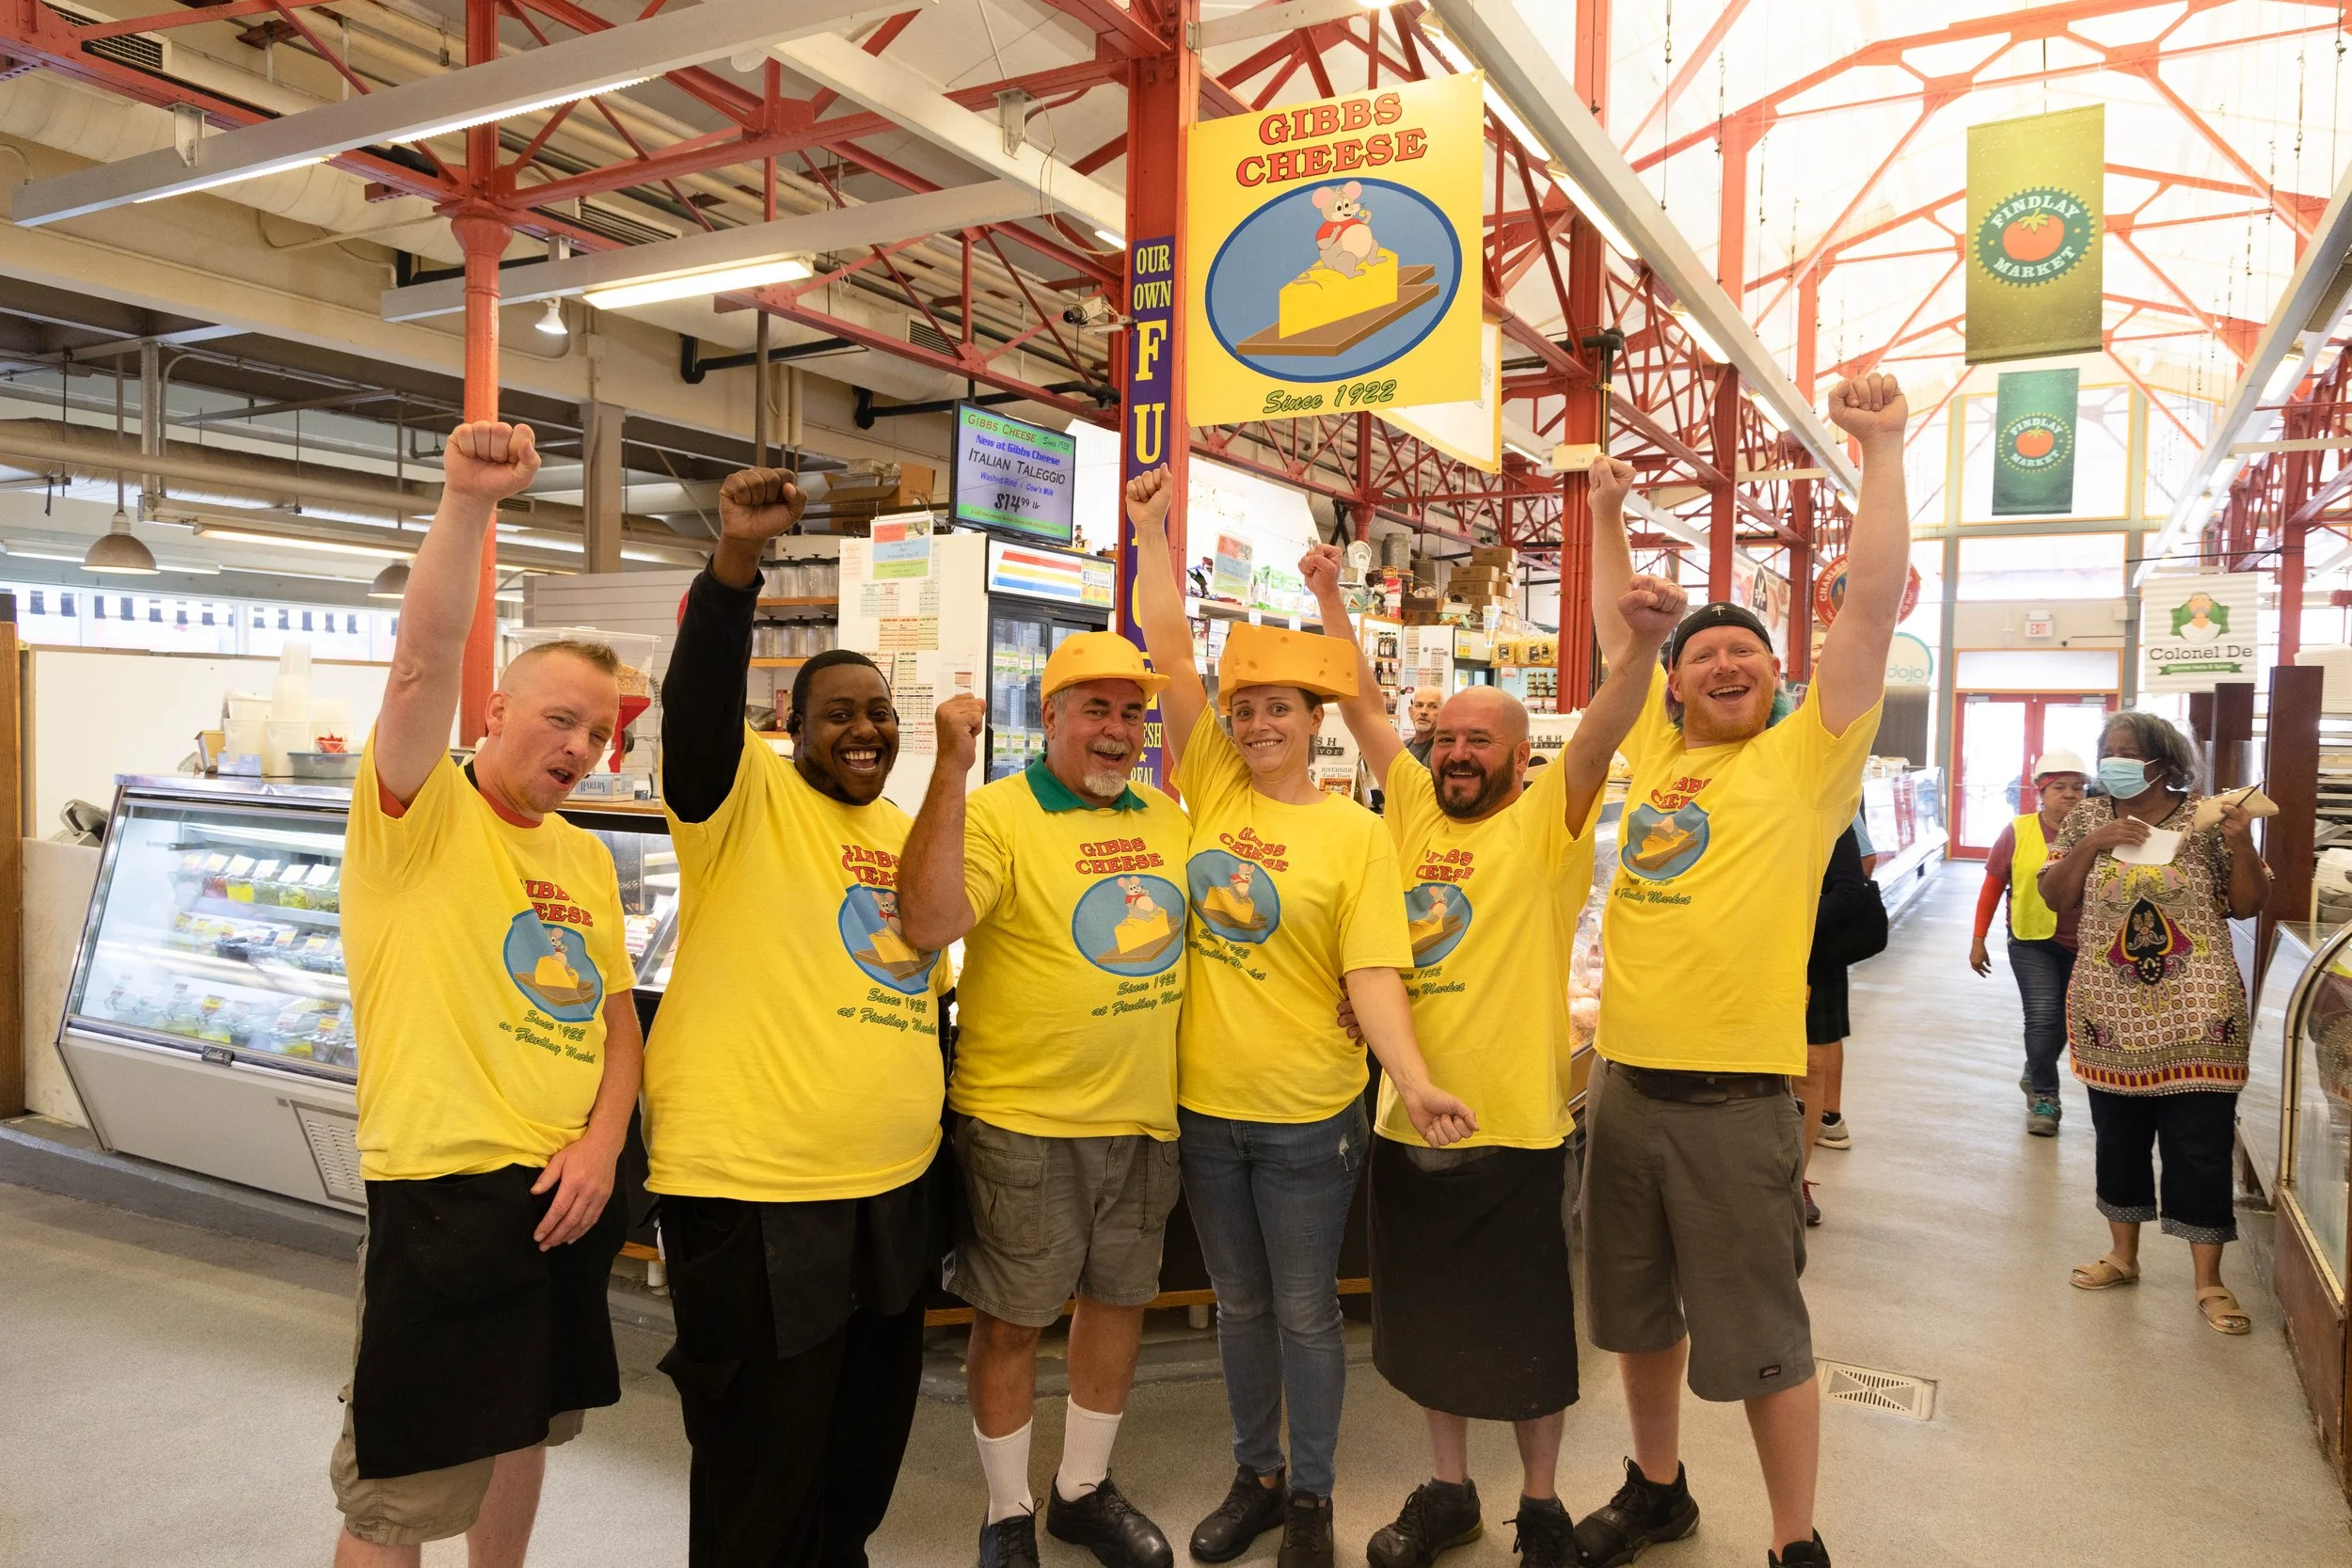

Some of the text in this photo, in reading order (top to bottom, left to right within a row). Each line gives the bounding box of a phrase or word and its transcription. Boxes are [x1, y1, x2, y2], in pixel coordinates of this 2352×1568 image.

[1259, 92, 1403, 146] GIBBS
[1235, 127, 1428, 187] CHEESE
[1991, 195, 2080, 229] FINDLAY
[1136, 245, 1170, 275] OUR
[1994, 245, 2076, 277] MARKET
[1134, 280, 1172, 310] OWN
[1263, 379, 1398, 414] Since 1922
[968, 414, 998, 432] GIBBS
[1002, 424, 1037, 443] CHEESE
[2010, 418, 2063, 436] FINDLAY
[976, 434, 1060, 466] New at Gibbs Cheese
[2010, 450, 2059, 467] MARKET
[968, 448, 1066, 484] ITALIAN TALEGGIO
[2150, 645, 2252, 660] Colonel De
[1144, 722, 1163, 748] ESH
[1080, 837, 1146, 857] GIBBS
[1075, 853, 1164, 875] CHEESE
[1648, 891, 1692, 904] Market
[532, 902, 594, 927] EESE
[1229, 956, 1266, 981] Maket
[1117, 972, 1176, 996] Since 1922
[1422, 981, 1465, 995] Market
[867, 988, 927, 1013] Since 1922
[1091, 1006, 1108, 1016] at
[1112, 997, 1157, 1016] Findlay
[524, 1010, 586, 1041] Since 1922
[837, 1007, 855, 1018] at
[860, 1007, 909, 1032] Findlay
[516, 1027, 561, 1055] Findlay
